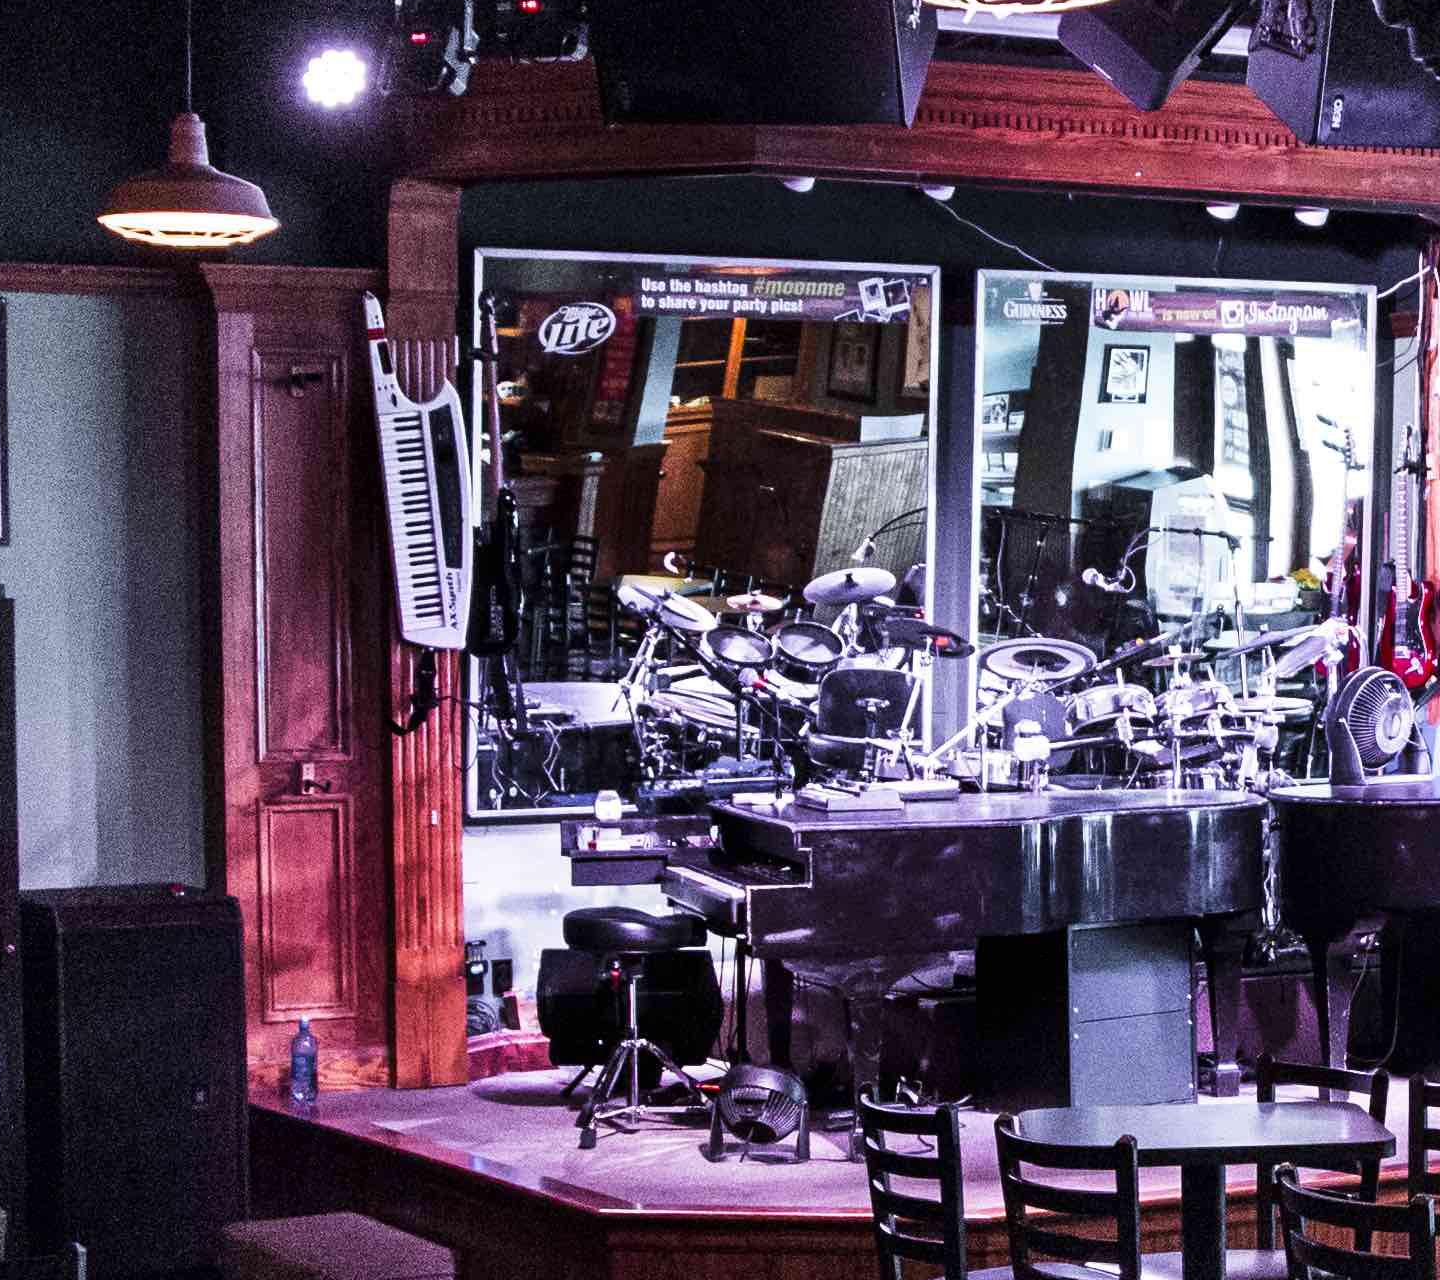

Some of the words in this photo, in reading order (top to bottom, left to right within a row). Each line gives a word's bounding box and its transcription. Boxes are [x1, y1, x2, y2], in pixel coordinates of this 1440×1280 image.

[641, 278, 666, 292] Use
[670, 278, 692, 292] the
[695, 279, 748, 297] hashtag
[753, 279, 847, 297] #moonme
[641, 295, 655, 308] to
[658, 296, 696, 310] share
[699, 299, 730, 313] your
[733, 298, 767, 314] party
[771, 299, 804, 314] pics!
[1003, 301, 1068, 319] GUINNESS
[1246, 300, 1328, 334] Instagram
[543, 314, 610, 353] Lite
